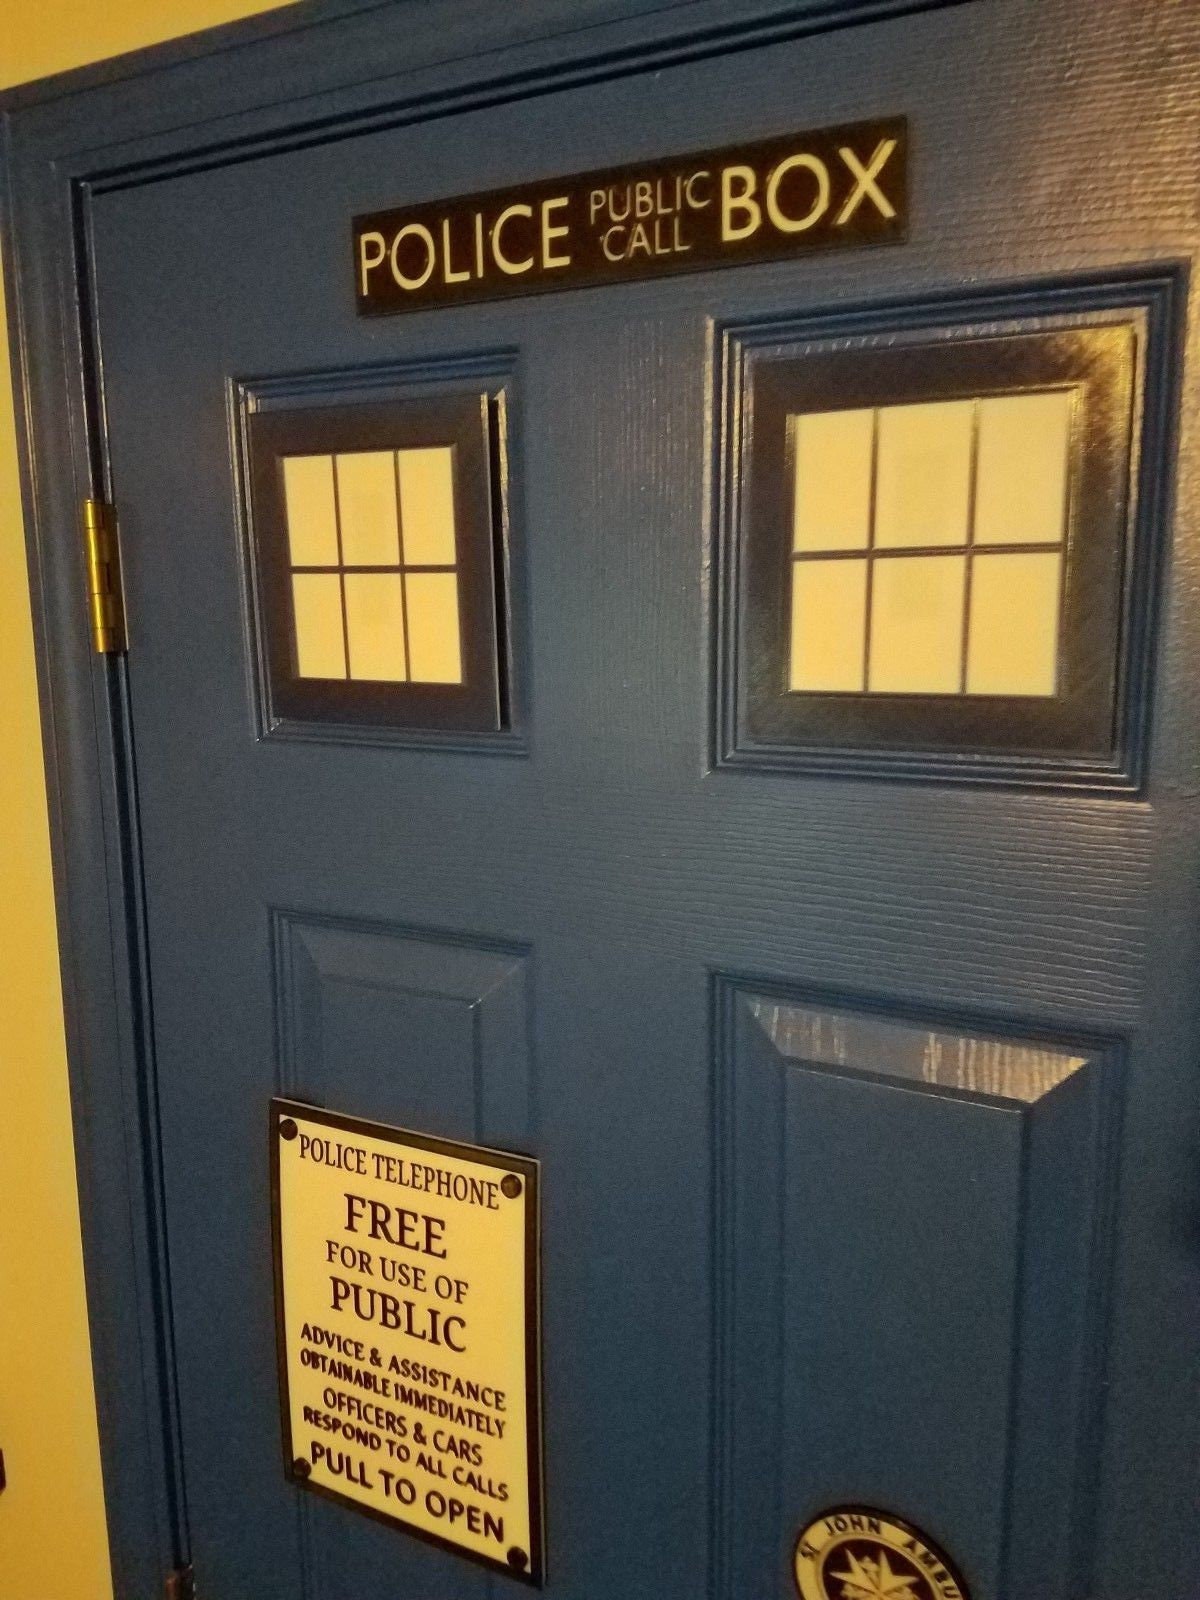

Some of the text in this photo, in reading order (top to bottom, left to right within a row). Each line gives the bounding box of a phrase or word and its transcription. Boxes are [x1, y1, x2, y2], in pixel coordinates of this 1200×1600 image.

[590, 171, 711, 225] PUBLIC
[721, 139, 897, 242] BOX
[360, 197, 571, 296] POLICE
[601, 217, 692, 262] CALL
[299, 1133, 499, 1210] POLICE TELEPHONE
[344, 1193, 447, 1259] FREE
[325, 1239, 469, 1304] FOR USE OF
[329, 1275, 467, 1352] PUBLIC
[300, 1323, 506, 1411] ADVICE & ASSISTANCE
[300, 1348, 506, 1440] OBTAINABLE IMMEDIATELY
[303, 1405, 509, 1501] RESPOND TO ALL CALLS
[323, 1387, 482, 1466] OFFICERS & CARS
[311, 1440, 504, 1543] PULL TO OPEN
[824, 1514, 881, 1536] JOHN
